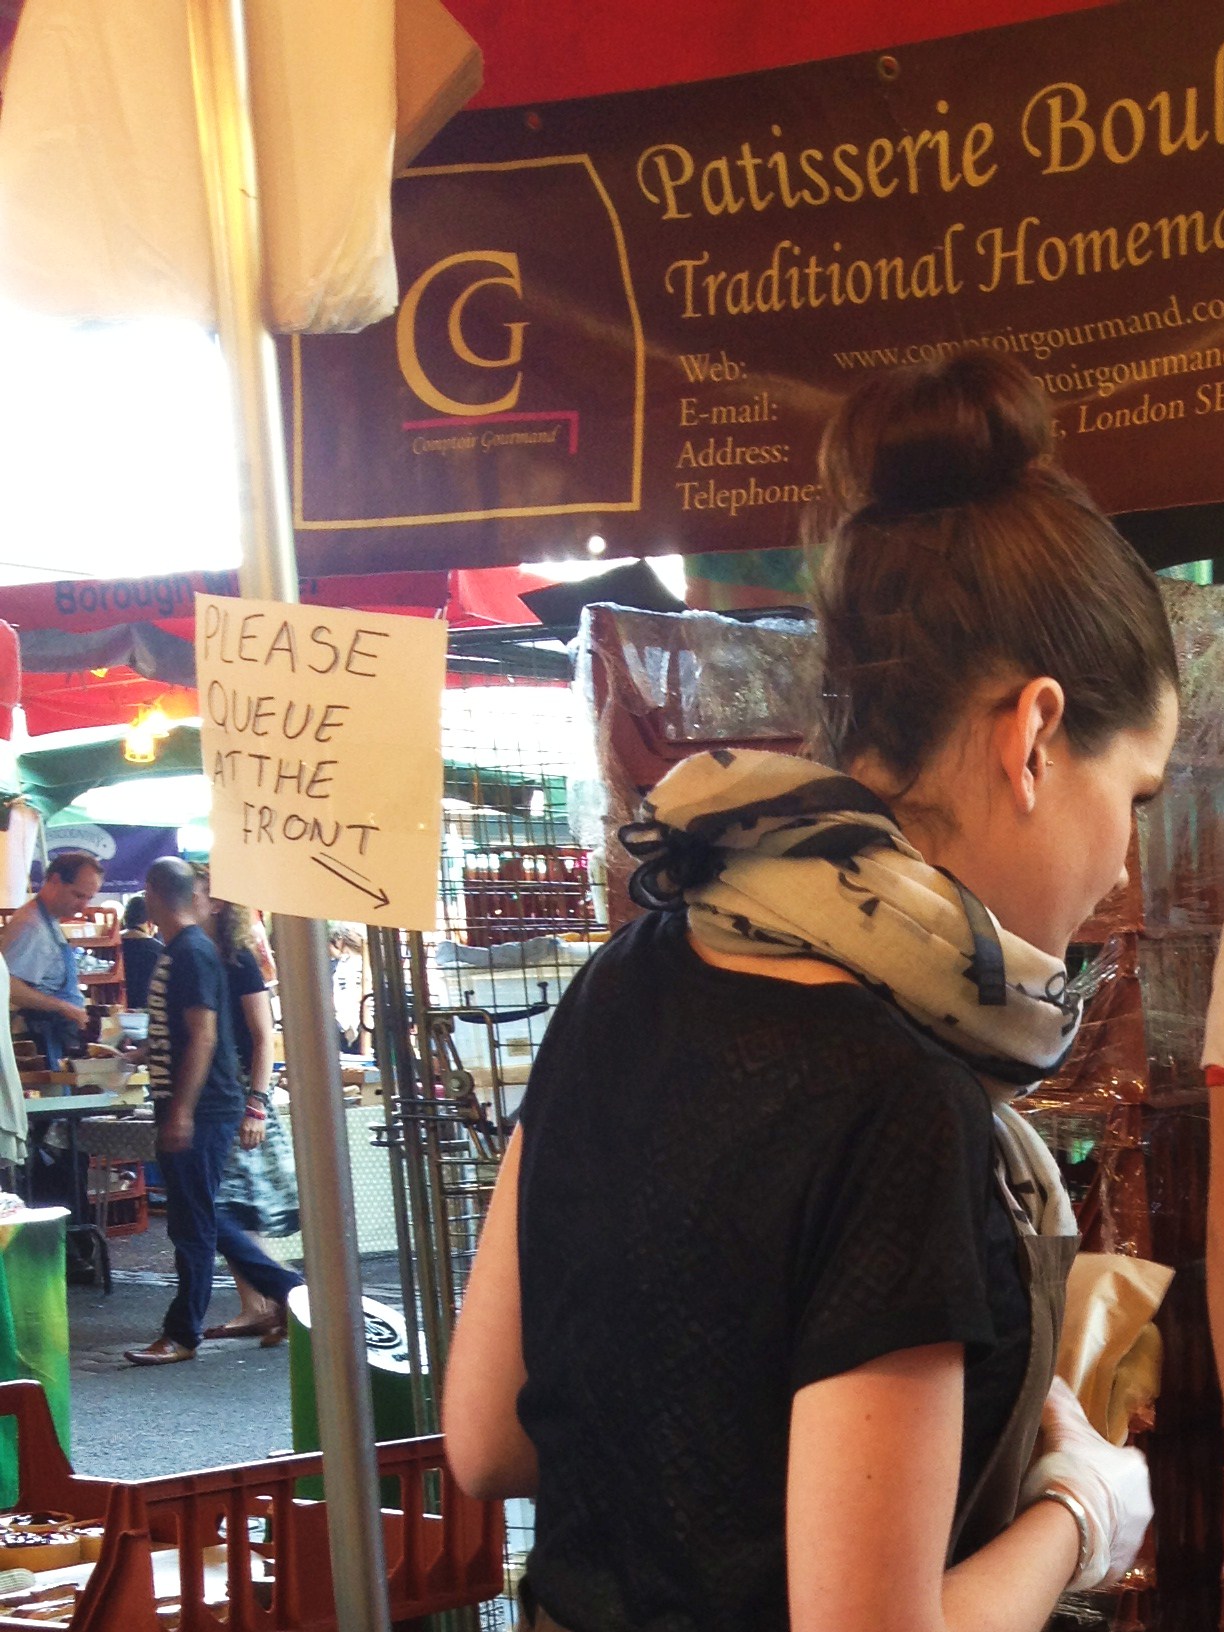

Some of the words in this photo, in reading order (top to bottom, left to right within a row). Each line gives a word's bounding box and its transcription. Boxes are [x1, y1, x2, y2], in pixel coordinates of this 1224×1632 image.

[637, 101, 998, 221] Patisserie
[665, 223, 966, 319] Traditional
[678, 351, 748, 383] Web:
[675, 436, 790, 469] Address:
[1078, 394, 1186, 434] London
[679, 391, 778, 427] E-mail:
[675, 477, 822, 517] Telephone:
[55, 574, 194, 616] Borough
[202, 604, 390, 678] PLEASE
[206, 680, 351, 743] QUEUE
[247, 753, 338, 799] THE
[242, 802, 381, 855] FRONT
